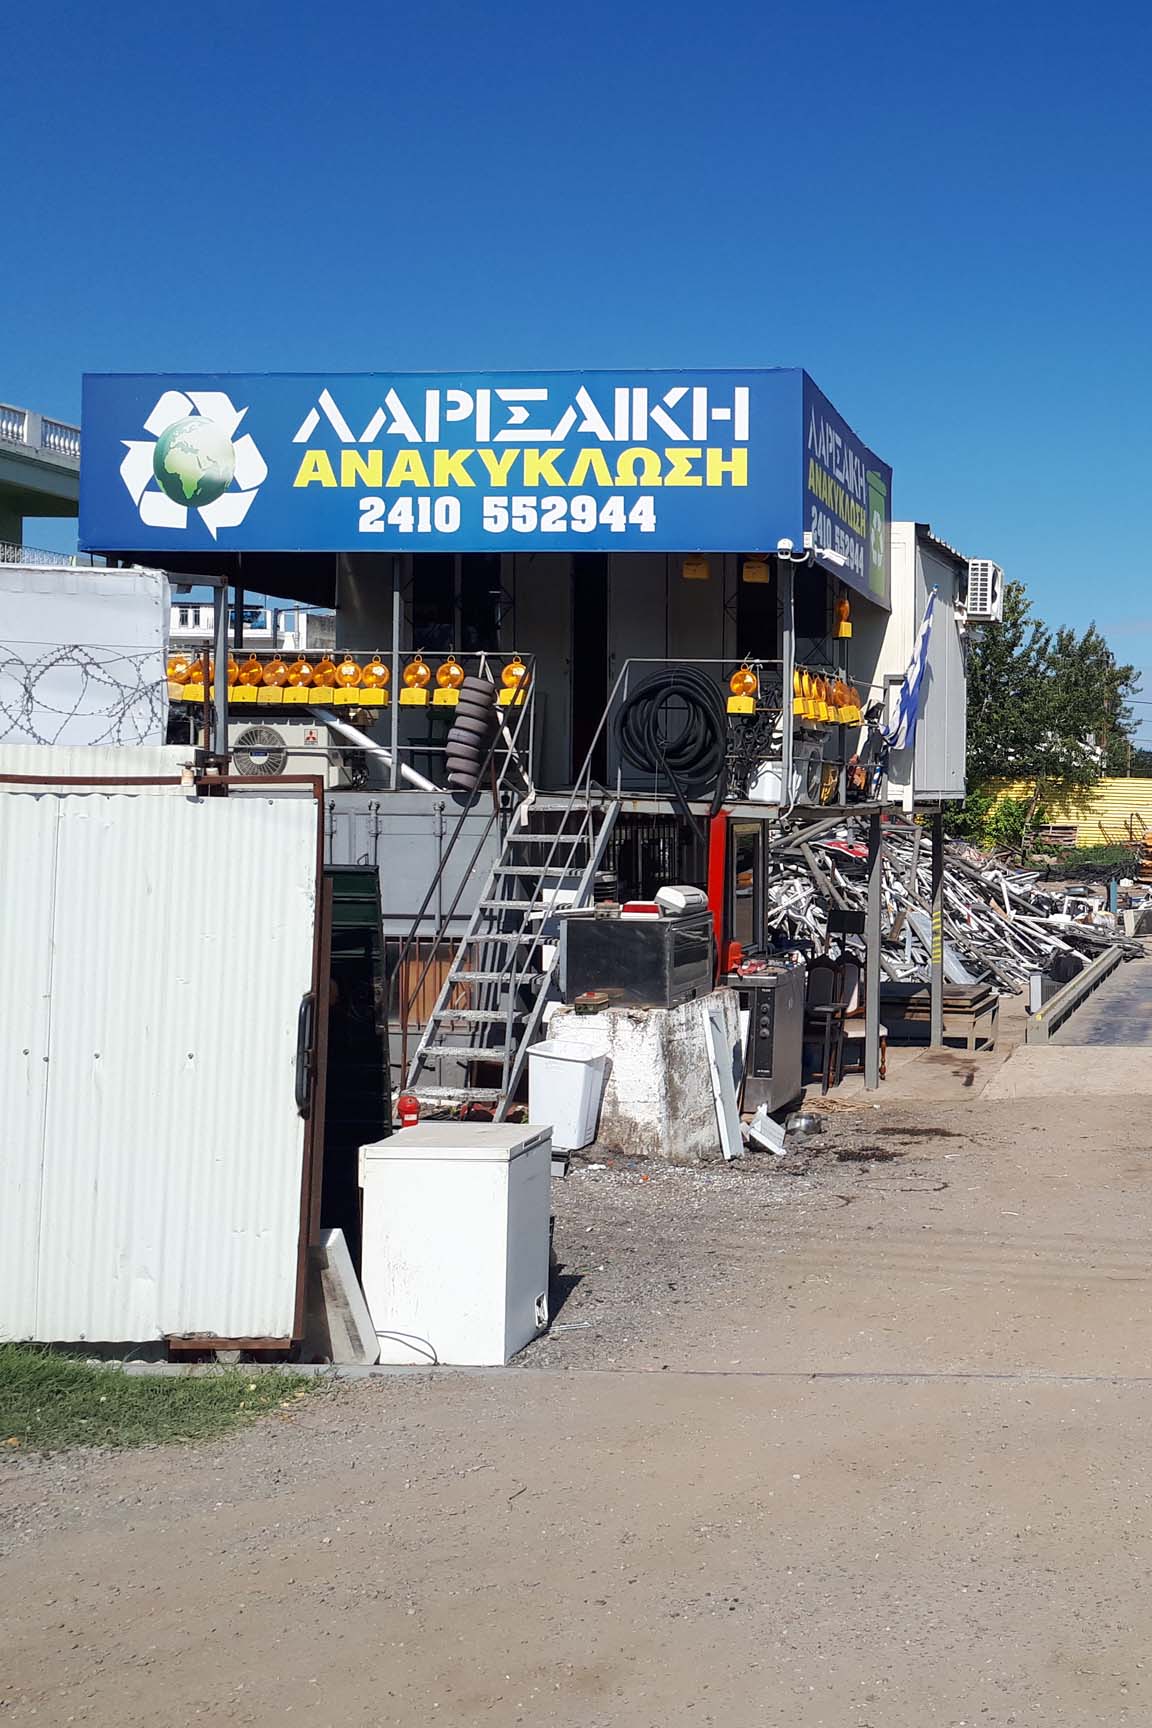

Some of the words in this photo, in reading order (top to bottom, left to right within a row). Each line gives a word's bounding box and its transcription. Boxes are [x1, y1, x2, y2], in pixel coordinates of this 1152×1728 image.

[292, 385, 750, 443] ΛΑΡΙΣΑΙΚΗ
[292, 446, 749, 488] ΑΝΑΚΥΚΛΩΣΗ
[358, 496, 461, 533] 2410
[482, 494, 657, 533] 552944
[808, 456, 867, 539] ΑΝΑΚΥΚΛΩΣΗ
[811, 504, 832, 549] 2410
[834, 524, 865, 577] 552944
